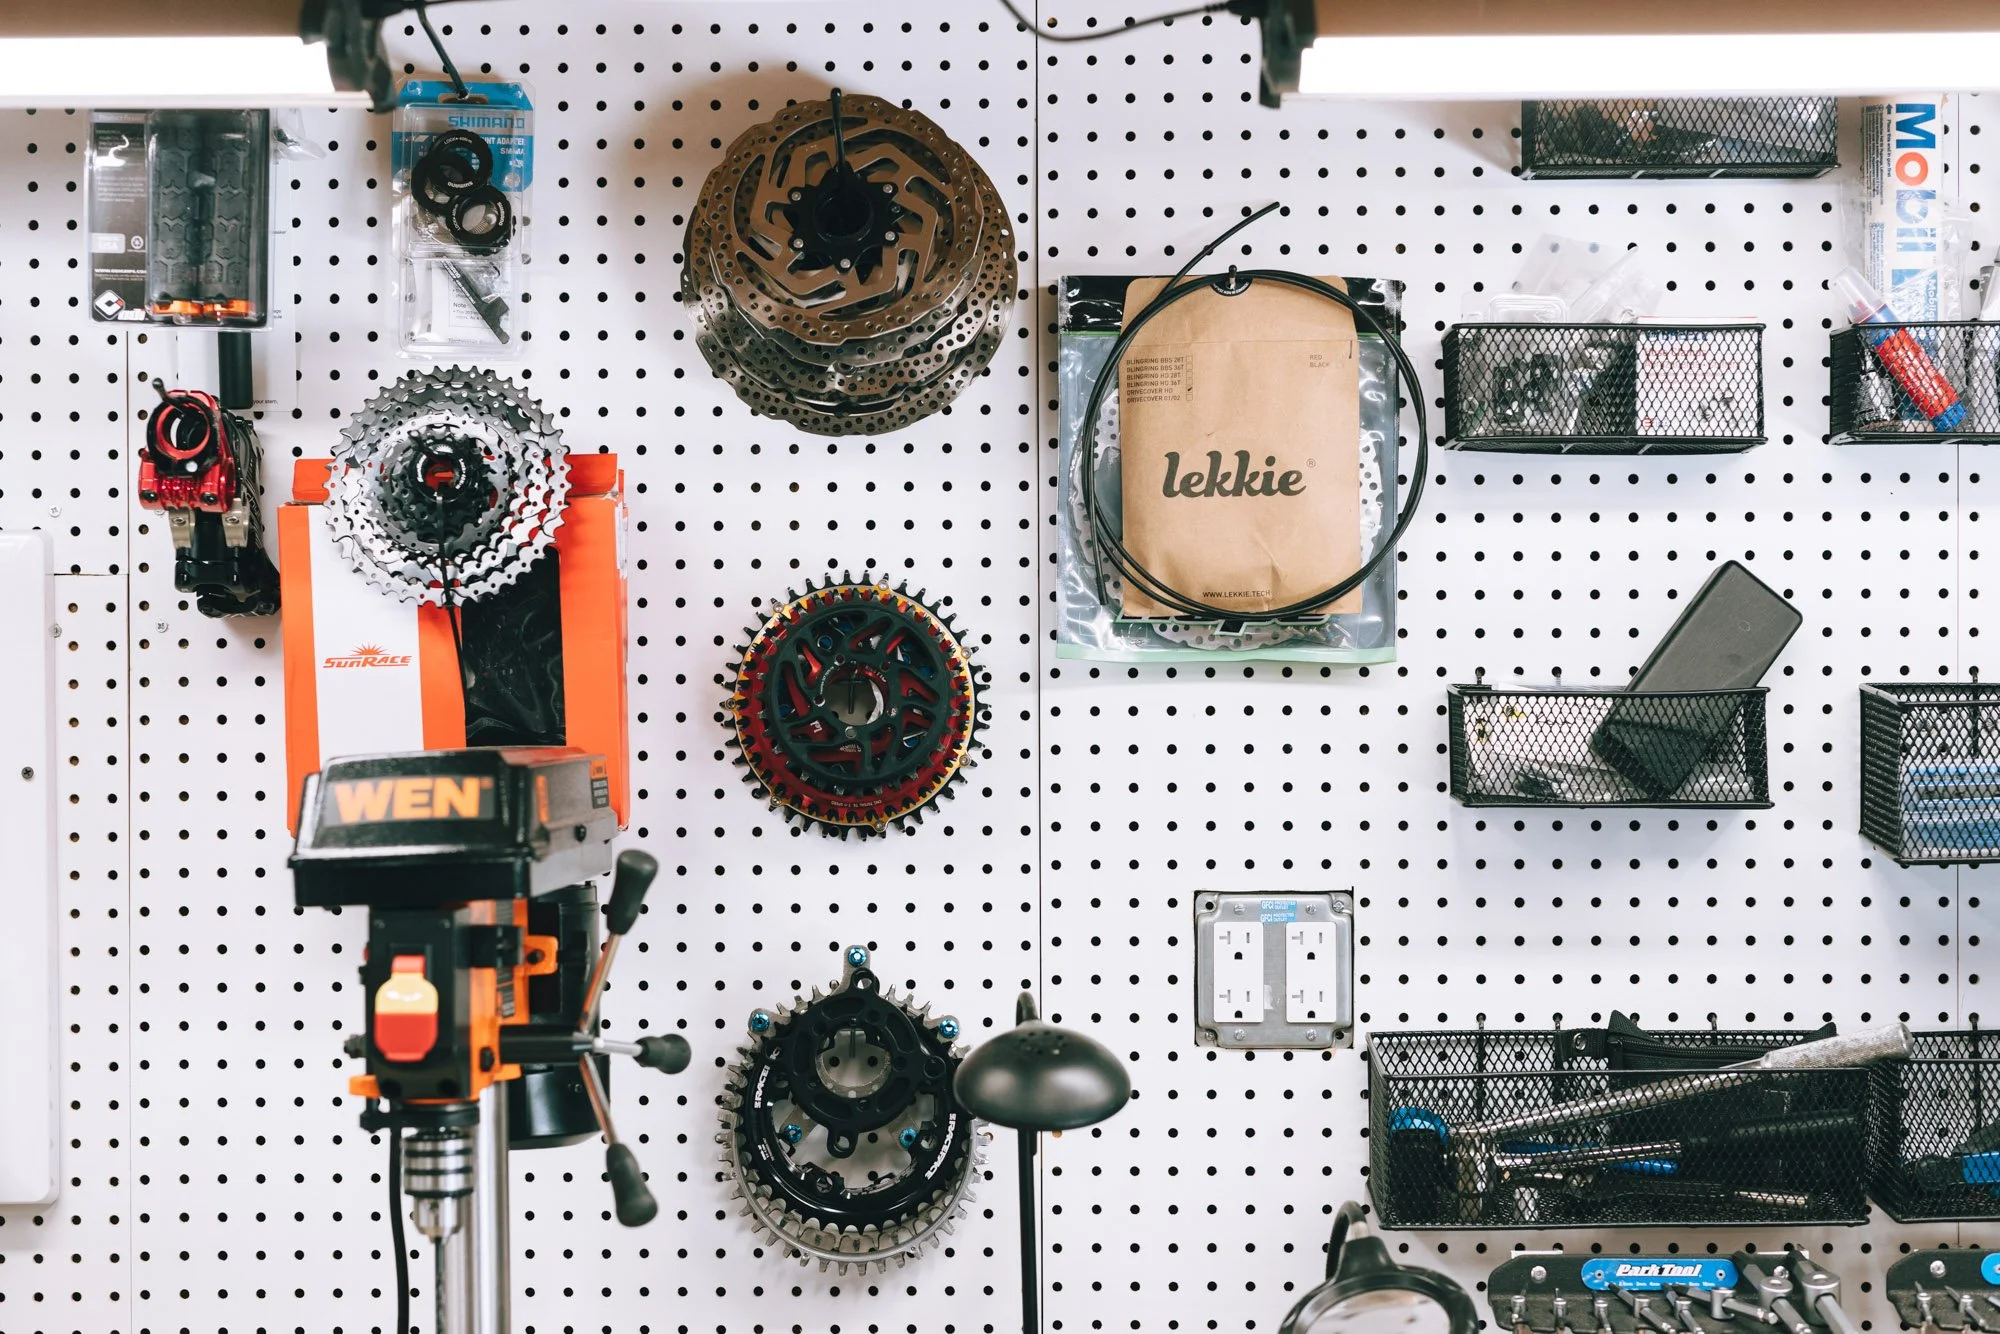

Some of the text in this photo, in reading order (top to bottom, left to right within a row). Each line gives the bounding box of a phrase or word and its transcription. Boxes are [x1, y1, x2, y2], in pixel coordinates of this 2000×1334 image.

[448, 115, 525, 129] SHIMANO
[1895, 104, 1936, 251] Mobil
[1126, 365, 1159, 373] BLINGRING
[1126, 380, 1159, 388] BLINGRING
[1126, 387, 1163, 396] DRIVECOVER
[1162, 449, 1307, 498] lekkie
[1202, 589, 1271, 598] WWW.LEKKIE.TECH
[334, 777, 481, 824] WEN
